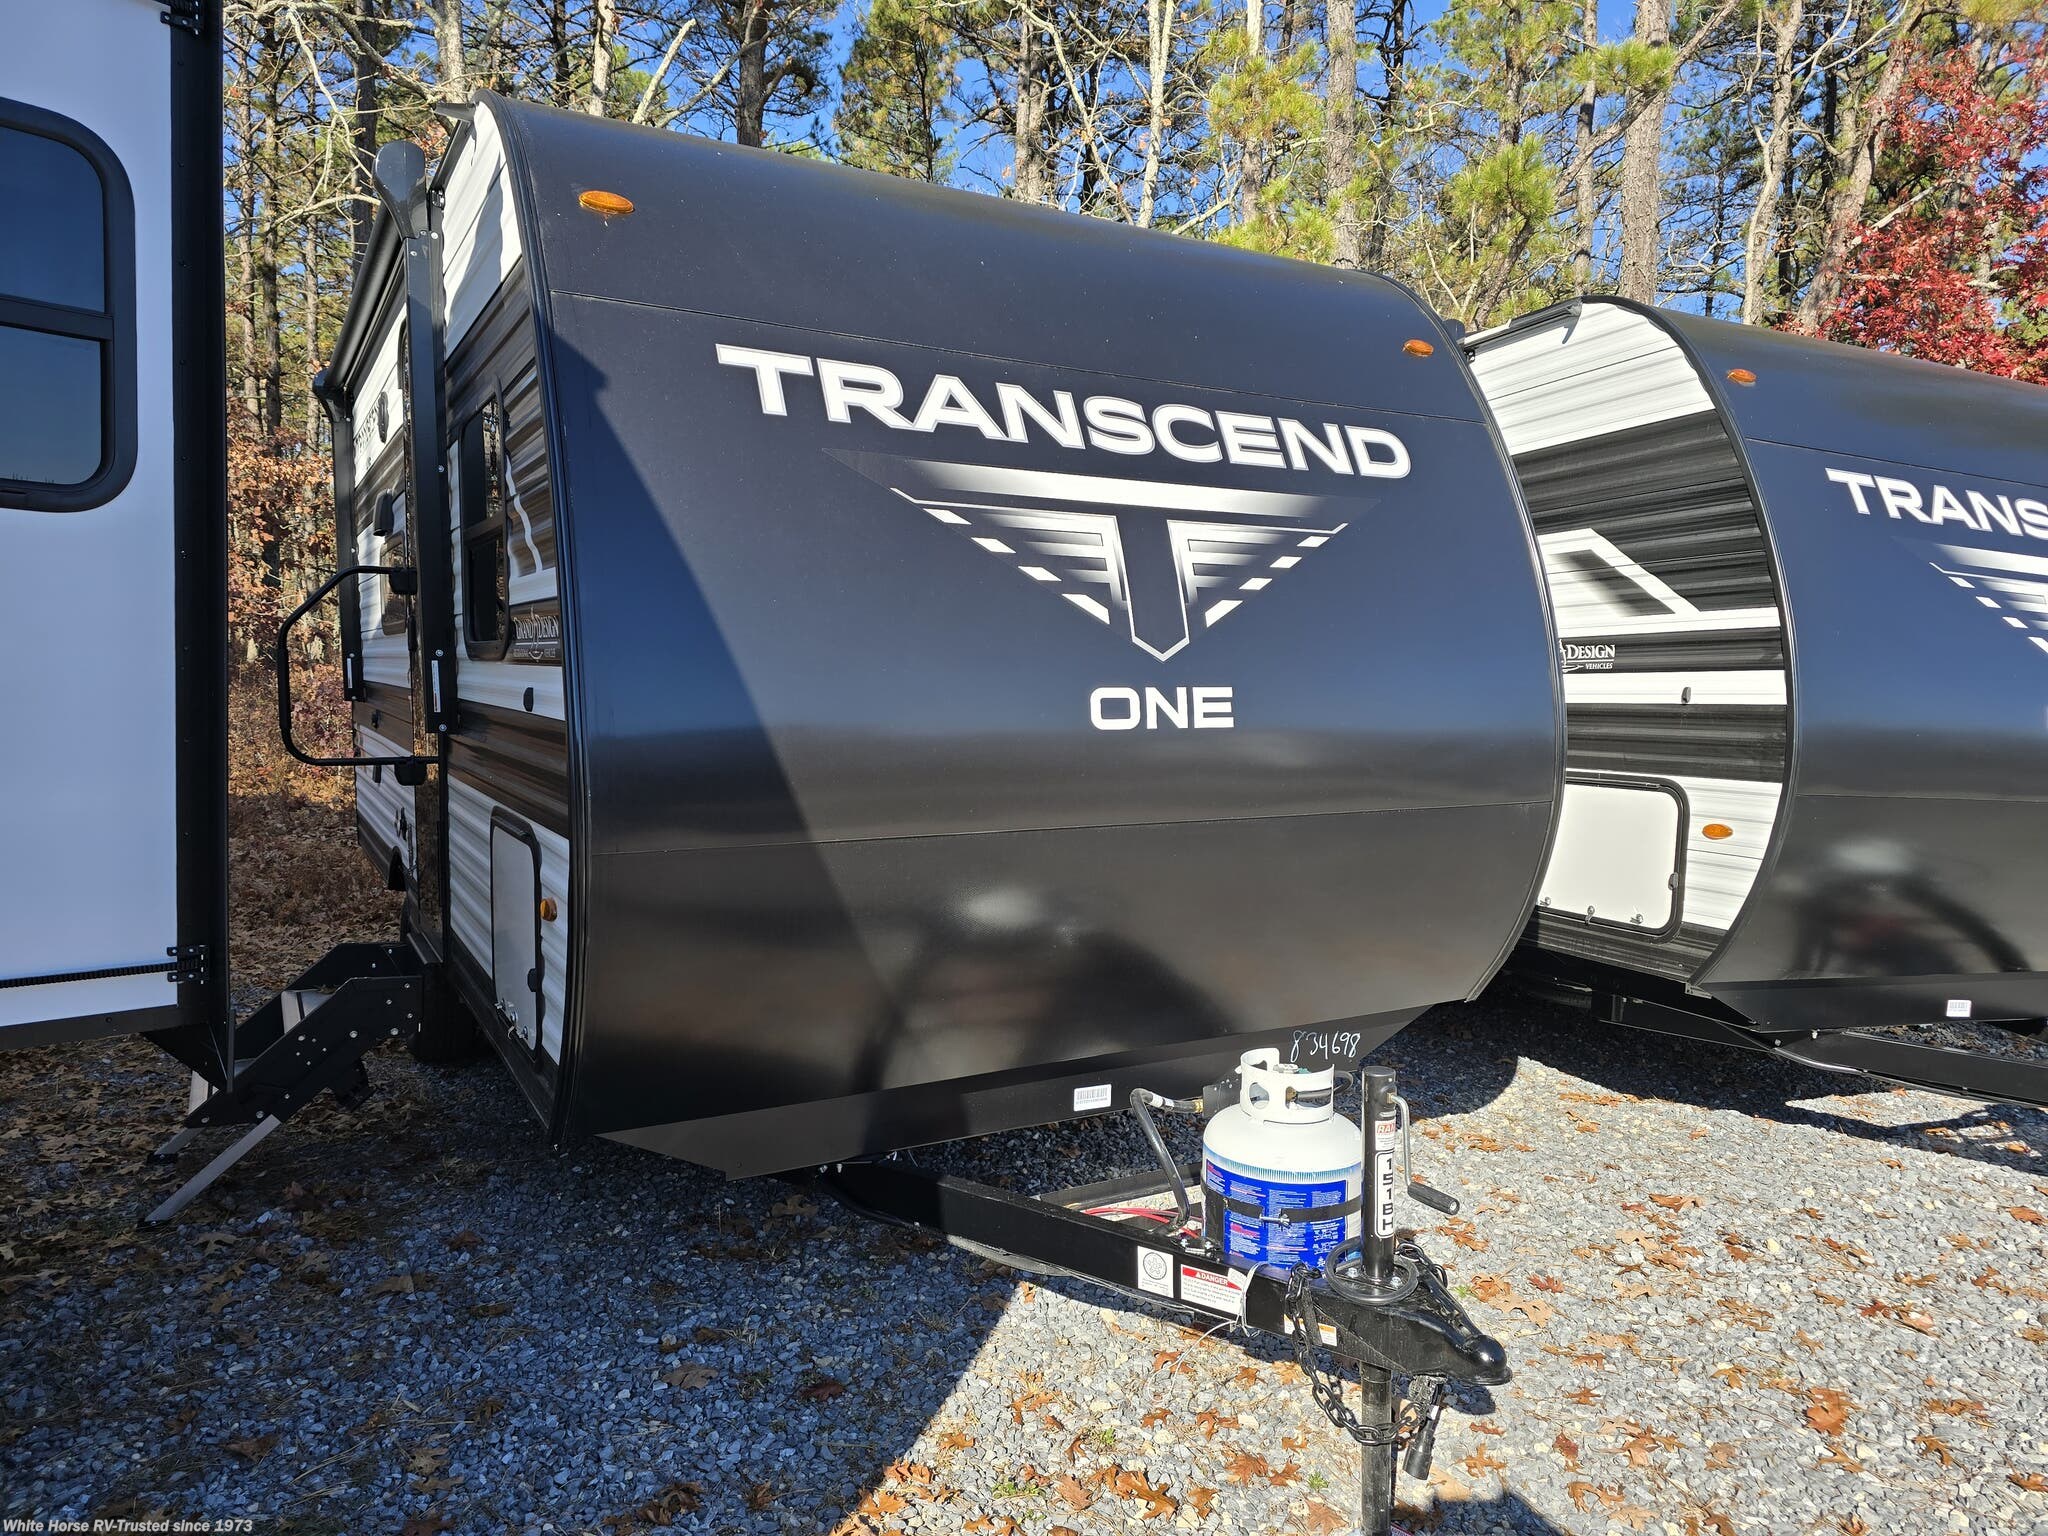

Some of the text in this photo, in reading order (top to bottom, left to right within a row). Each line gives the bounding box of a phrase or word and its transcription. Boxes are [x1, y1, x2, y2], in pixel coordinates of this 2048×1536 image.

[715, 344, 1412, 479] TRANSCEND
[1565, 644, 1616, 660] DESIGN
[1585, 662, 1613, 670] VEHICLES
[1090, 687, 1235, 731] ONE
[1290, 1030, 1361, 1063] 834698
[1200, 1272, 1229, 1286] DANGER
